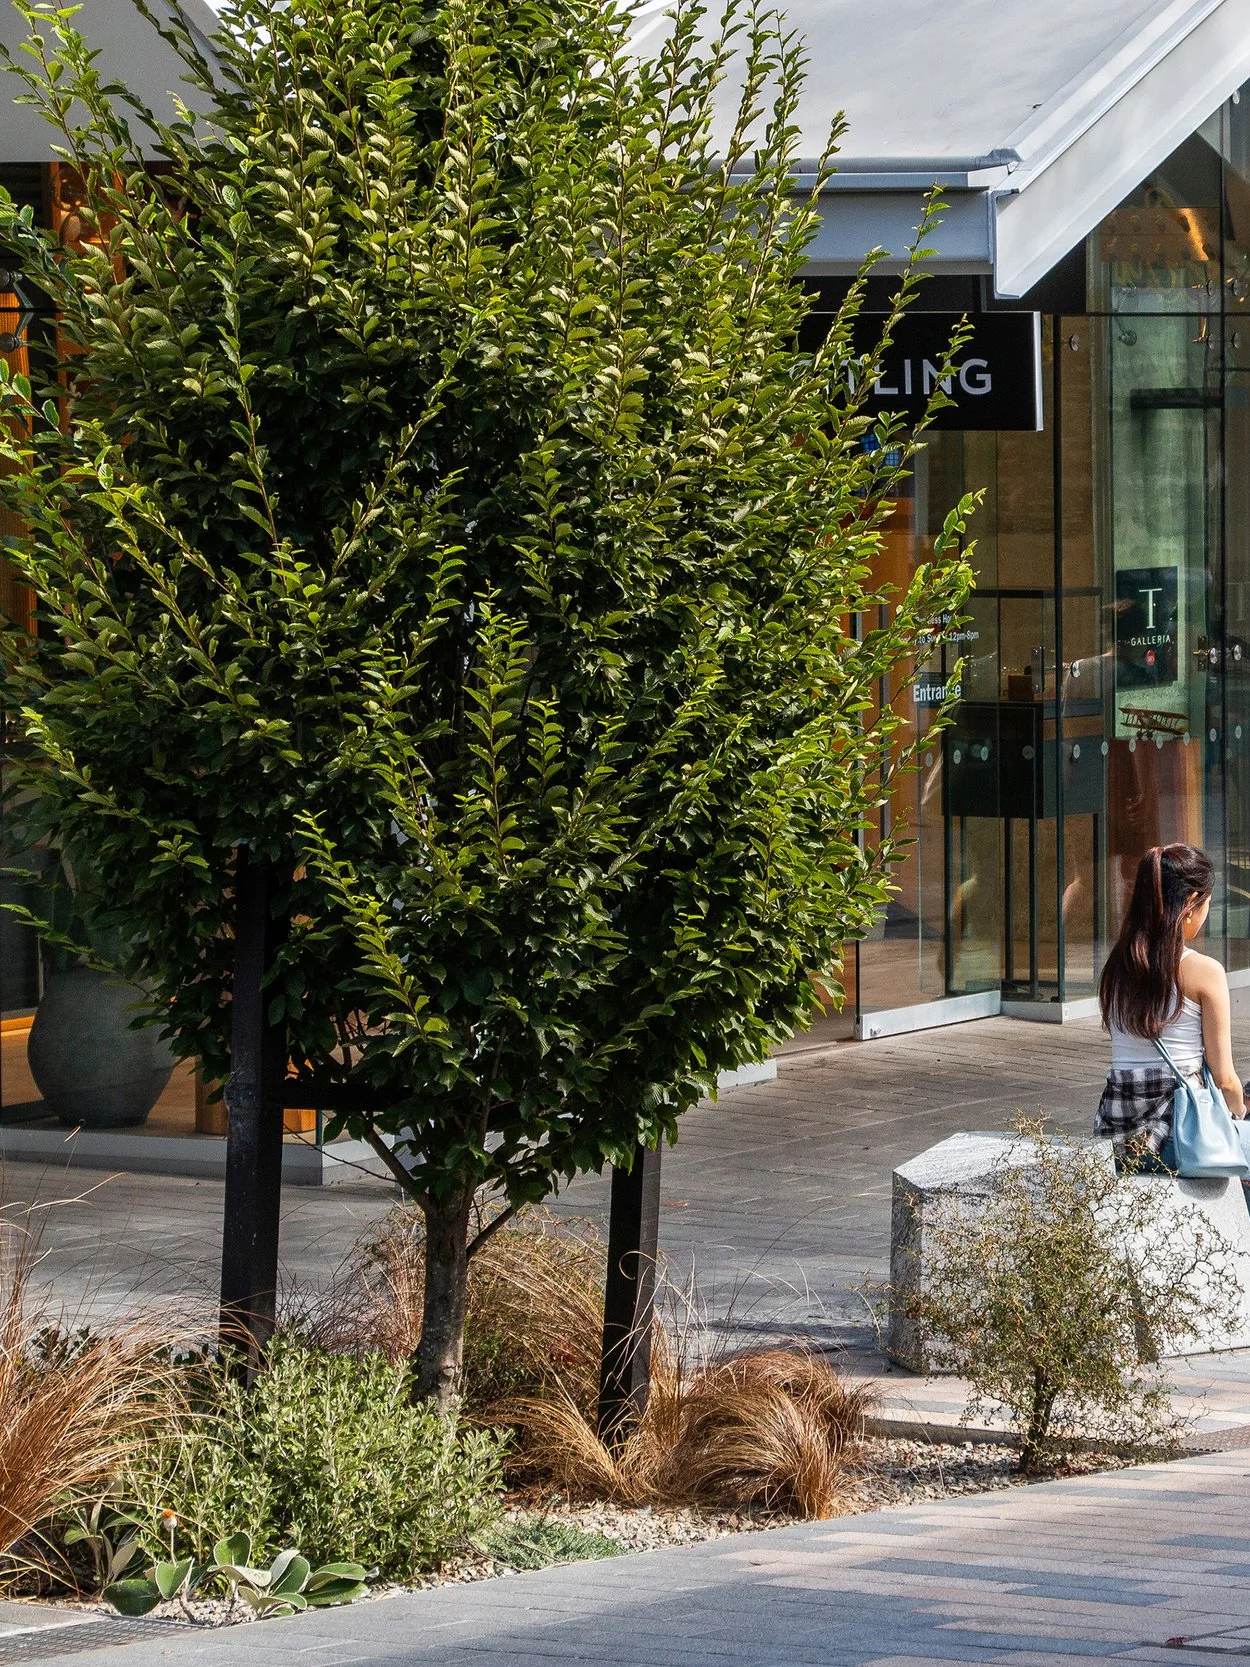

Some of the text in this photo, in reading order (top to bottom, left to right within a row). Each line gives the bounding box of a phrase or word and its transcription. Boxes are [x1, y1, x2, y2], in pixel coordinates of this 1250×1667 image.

[1139, 588, 1162, 628] T
[1130, 634, 1171, 647] GALLERIA
[913, 683, 962, 702] Entrane
